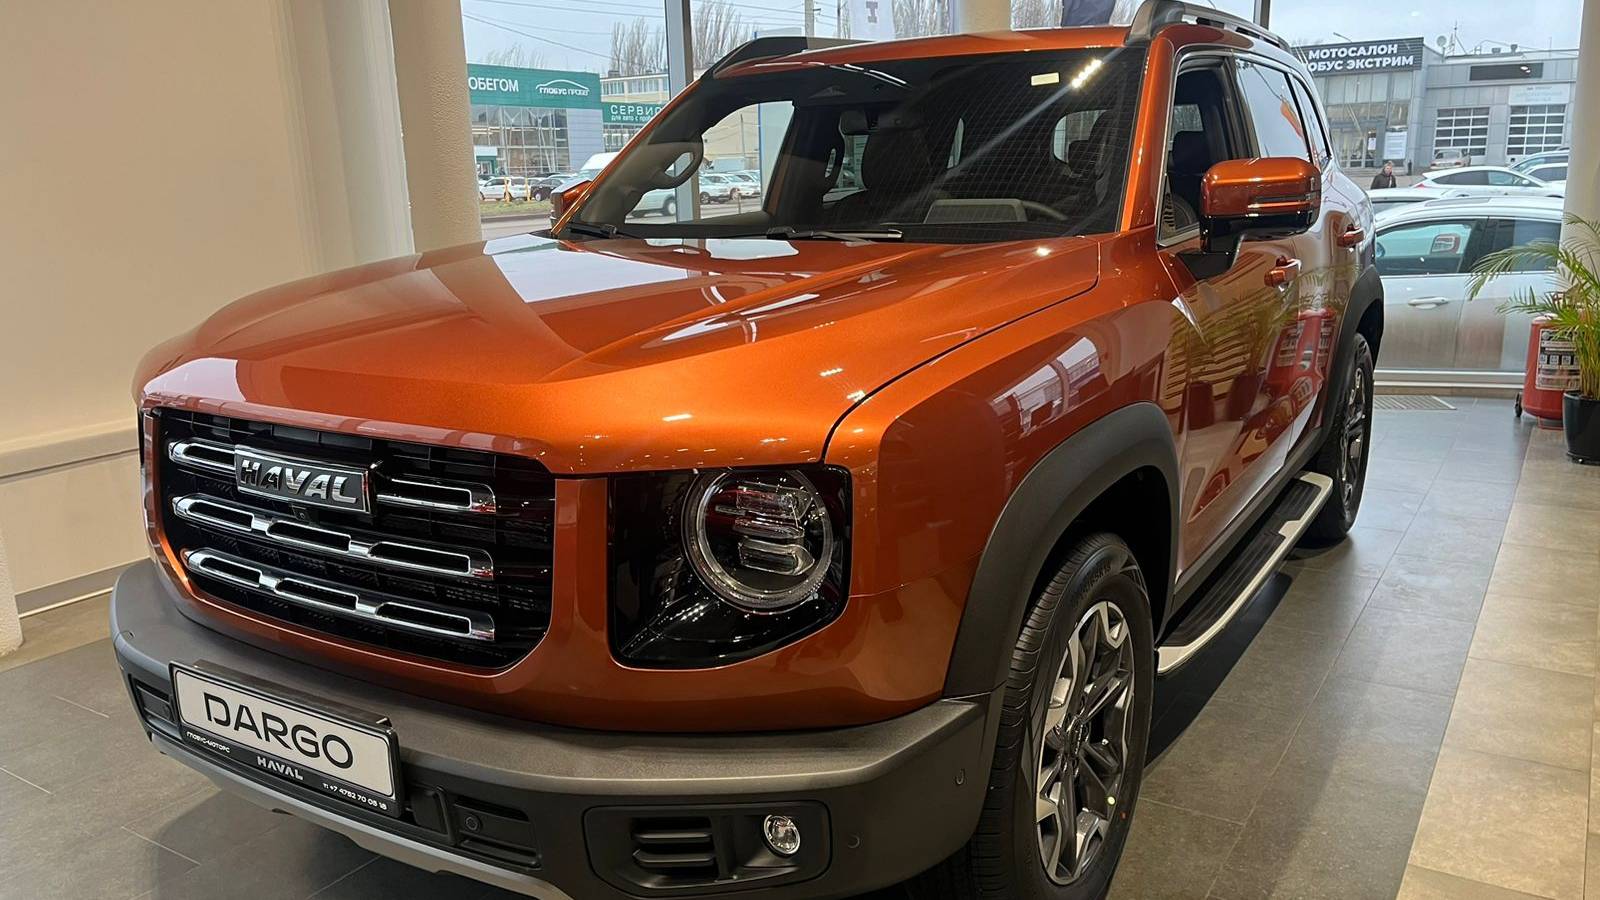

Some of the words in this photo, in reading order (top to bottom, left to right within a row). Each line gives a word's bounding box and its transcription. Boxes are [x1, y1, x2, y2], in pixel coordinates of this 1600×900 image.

[1308, 44, 1398, 60] МОТОСАЛОН
[1346, 55, 1414, 70] ЭКСТРИМ
[539, 87, 567, 95] ГЛОБУС
[240, 459, 357, 504] HAVAL
[203, 692, 354, 769] DARGO
[256, 755, 304, 781] HAVAL
[357, 794, 367, 803] 70
